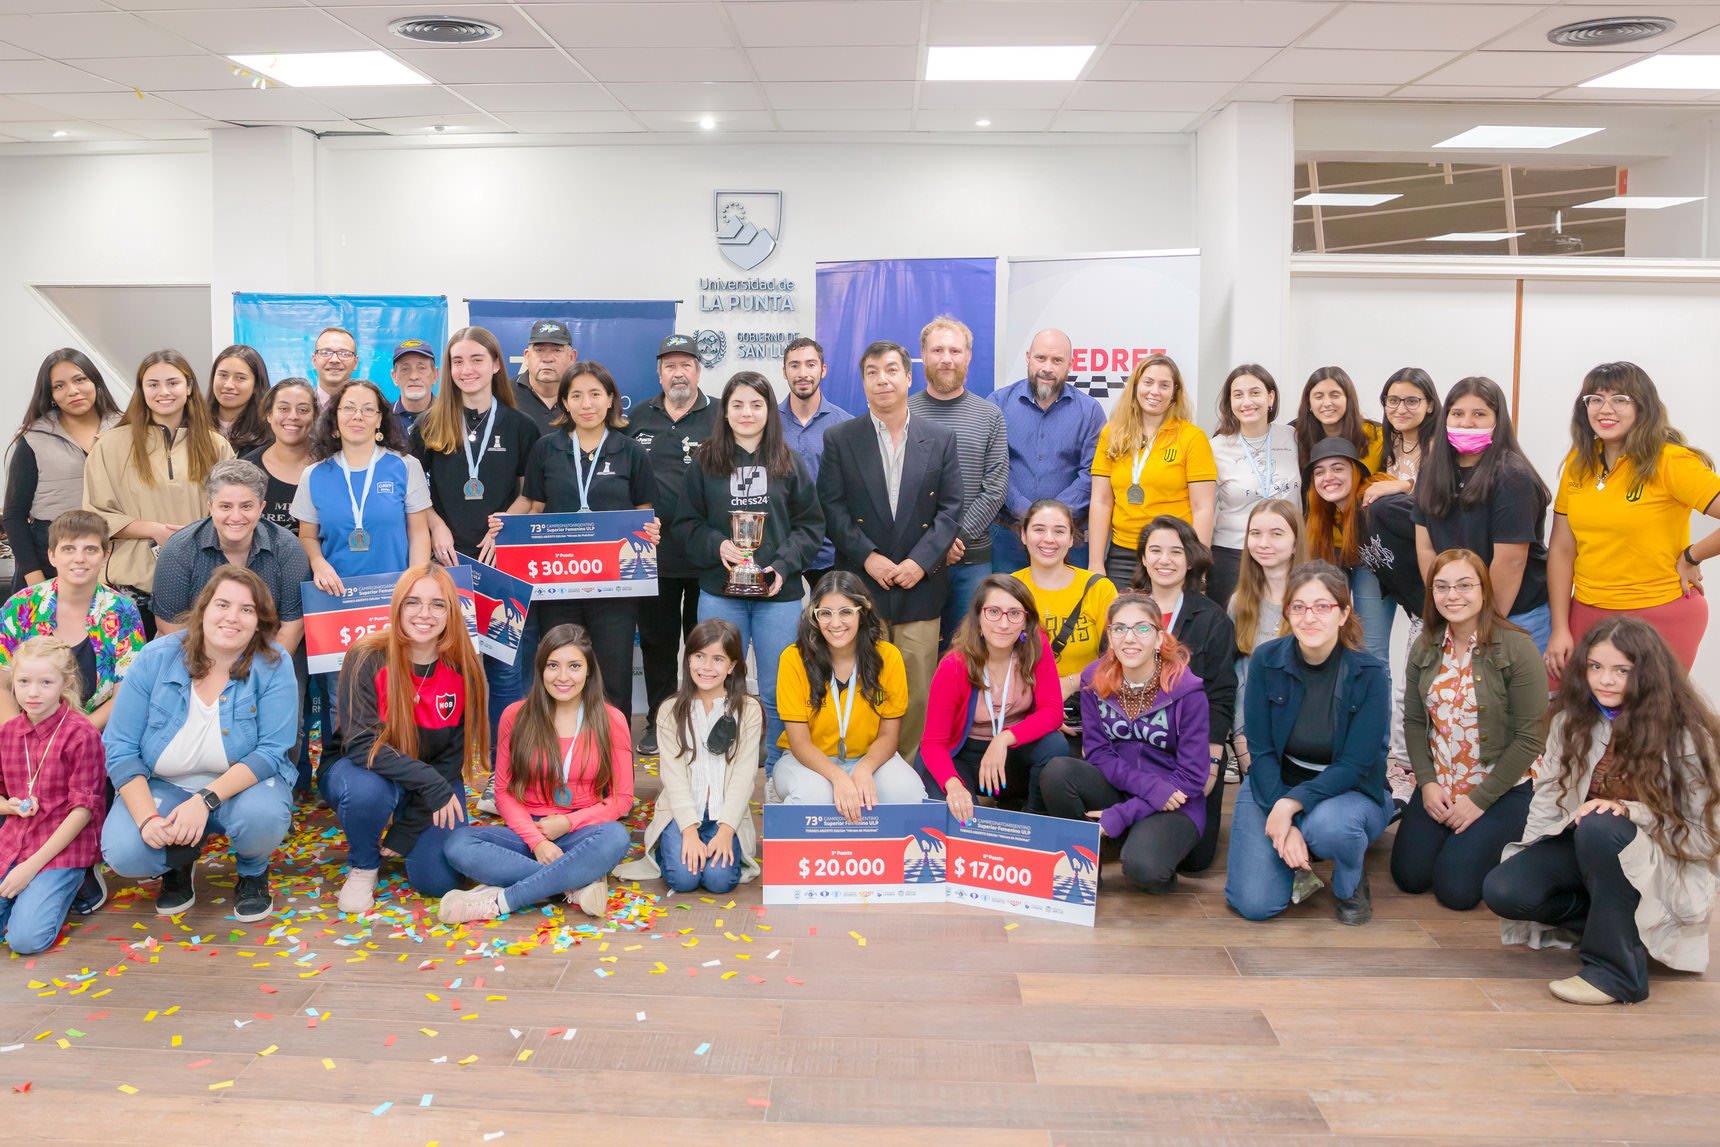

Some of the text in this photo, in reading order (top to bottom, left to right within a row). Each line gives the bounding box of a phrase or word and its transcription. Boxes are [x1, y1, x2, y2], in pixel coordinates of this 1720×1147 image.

[699, 277, 795, 291] Universidad de
[701, 295, 795, 312] LA PUNTA
[737, 332, 785, 343] GOBIERNO
[738, 343, 767, 359] SAN
[731, 496, 767, 506] chess24
[528, 559, 603, 579] $ 30.000
[340, 626, 351, 646] $
[439, 701, 453, 709] NOB
[798, 857, 885, 879] $ 20.000
[954, 856, 1032, 887] $ 17.000
